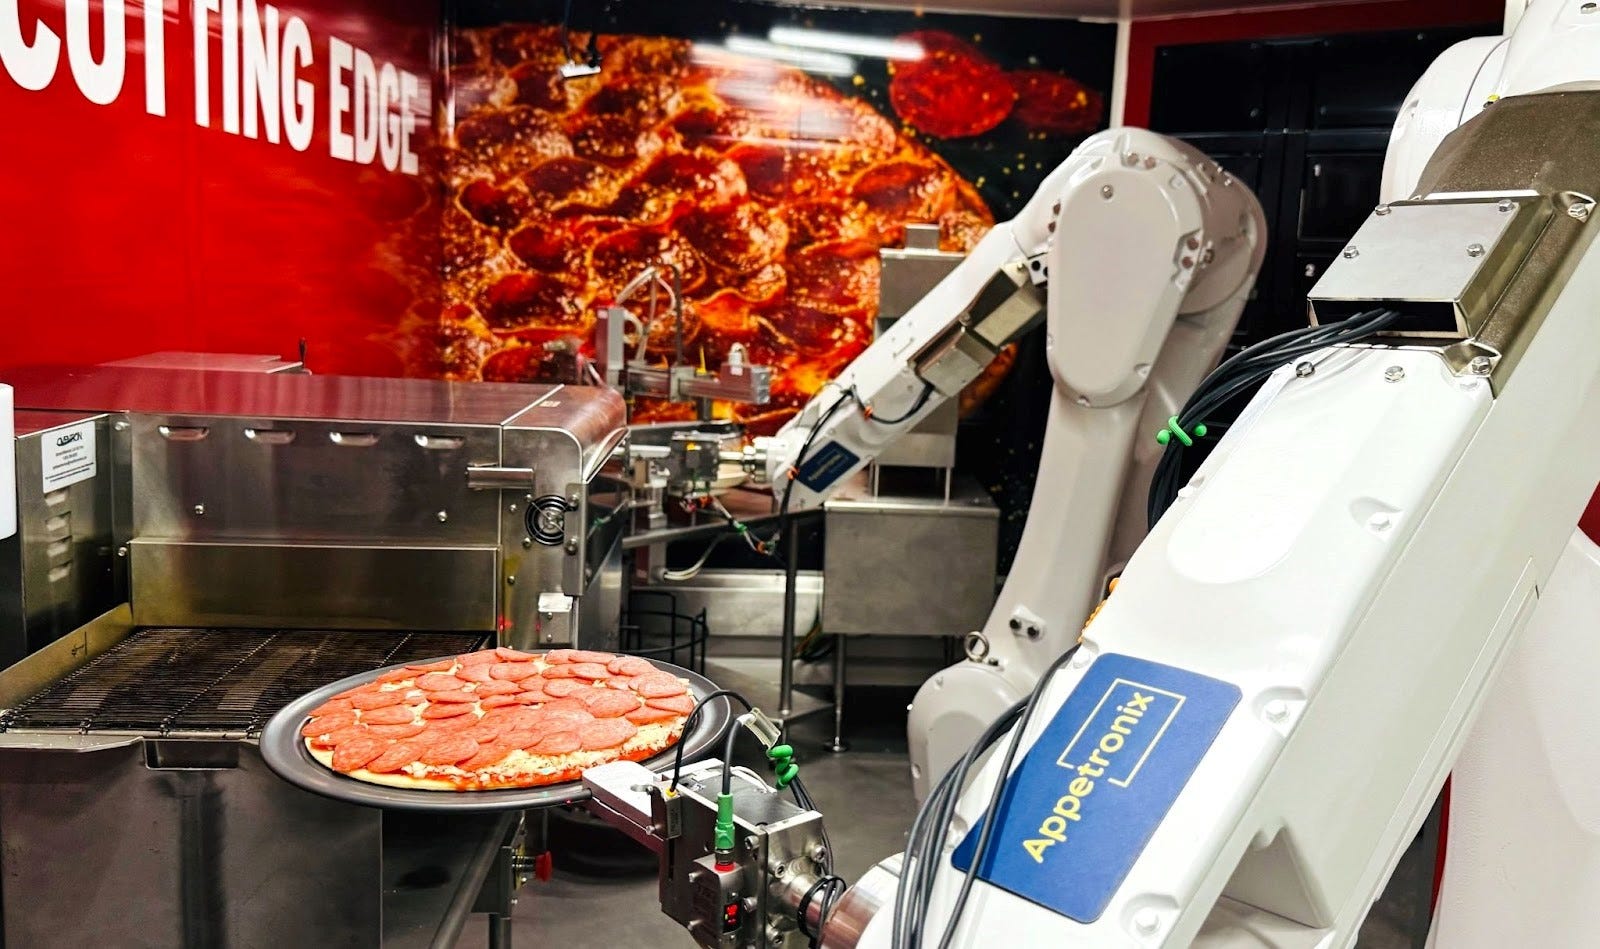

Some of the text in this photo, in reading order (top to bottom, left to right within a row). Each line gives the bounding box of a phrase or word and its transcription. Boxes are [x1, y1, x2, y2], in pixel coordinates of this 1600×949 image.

[330, 36, 419, 175] EDGE
[1305, 263, 1316, 277] 2
[1022, 692, 1154, 863] Appetronix
